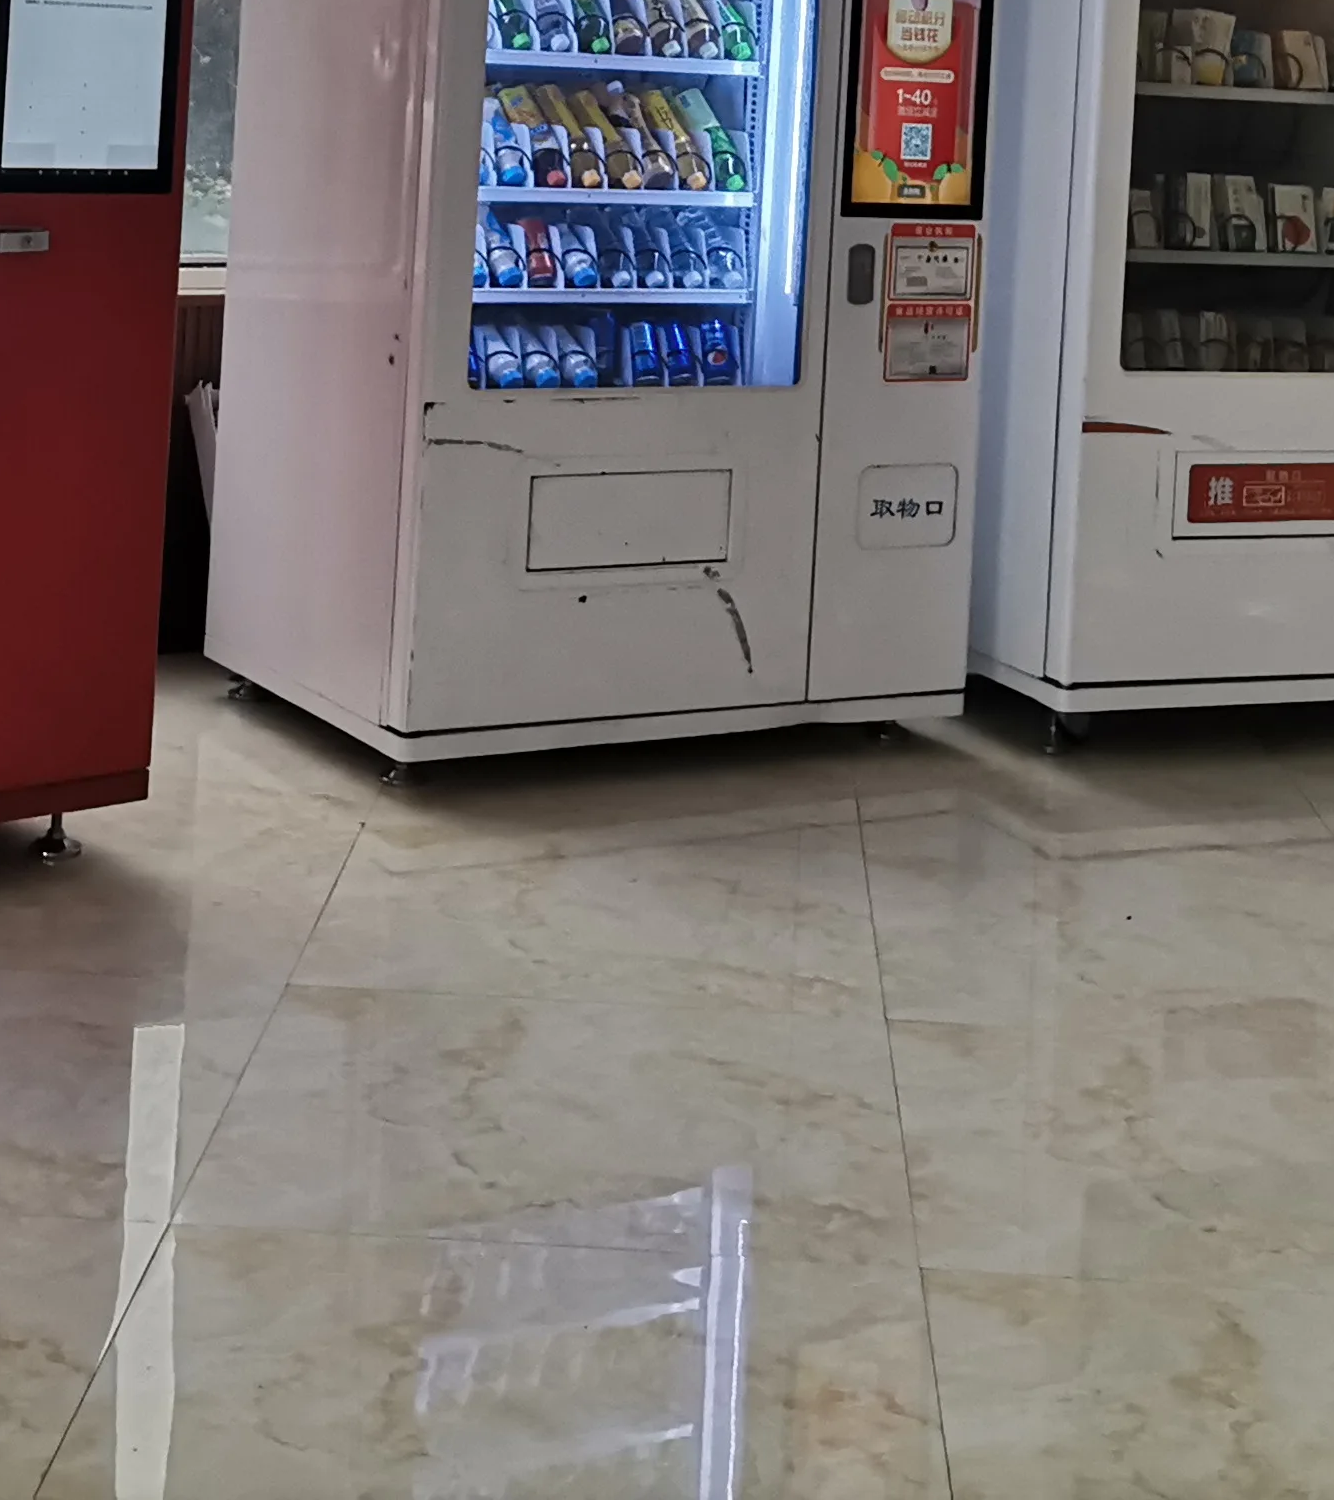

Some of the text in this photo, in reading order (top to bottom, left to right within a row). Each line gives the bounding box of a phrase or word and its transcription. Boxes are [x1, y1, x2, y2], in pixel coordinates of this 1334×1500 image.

[1208, 476, 1235, 507] 推
[870, 498, 944, 520] 取物口
